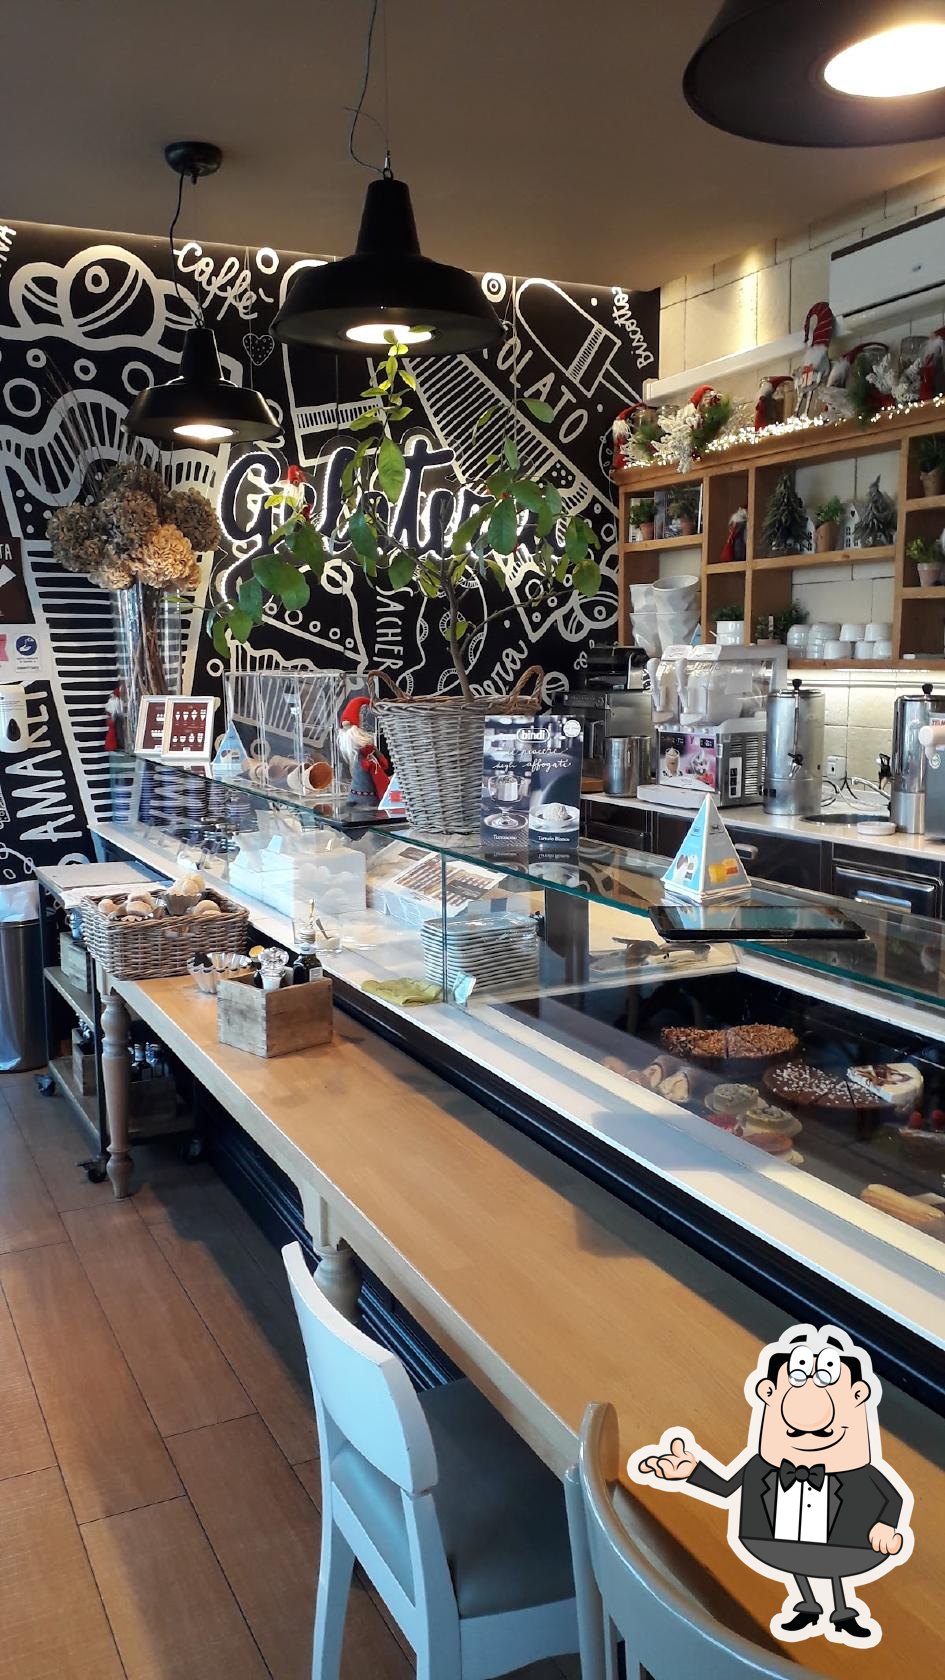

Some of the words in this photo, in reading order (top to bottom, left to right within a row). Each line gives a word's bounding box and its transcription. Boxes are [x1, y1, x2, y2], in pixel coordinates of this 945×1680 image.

[496, 334, 589, 444] OLATO
[373, 585, 414, 671] SACHER
[521, 729, 546, 740] bindi
